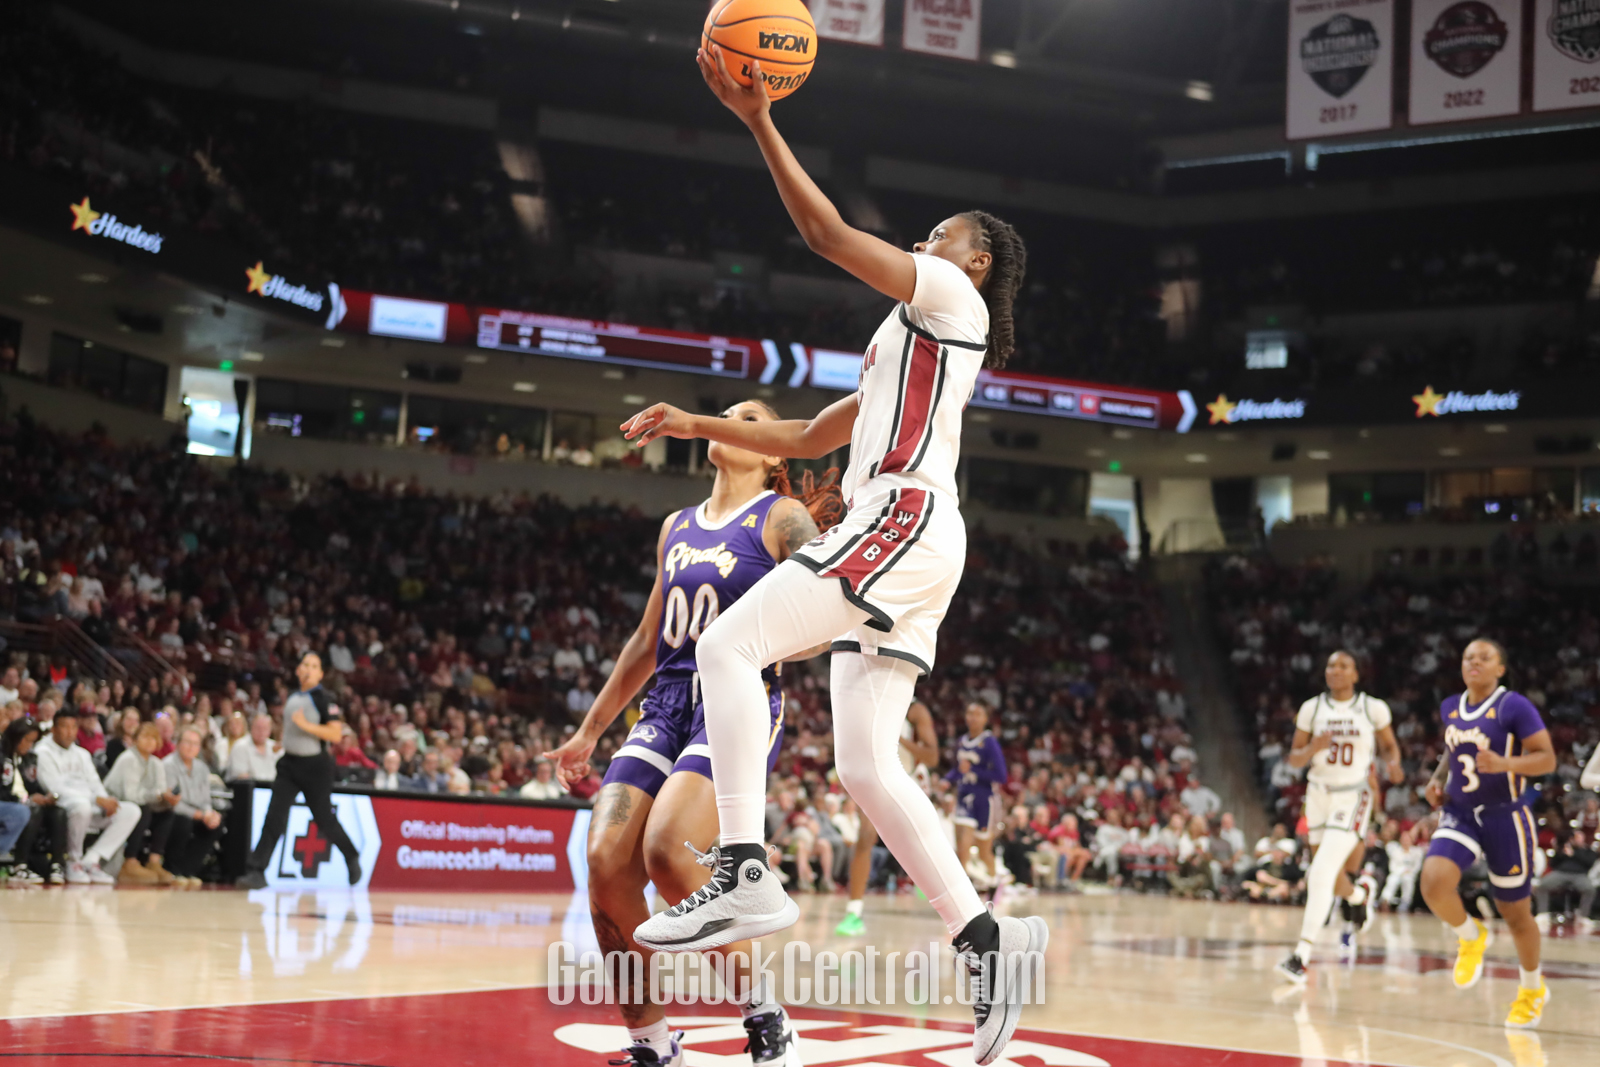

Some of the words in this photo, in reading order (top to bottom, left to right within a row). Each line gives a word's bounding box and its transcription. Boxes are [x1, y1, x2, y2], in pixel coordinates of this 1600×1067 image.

[758, 31, 810, 54] NCAA
[1430, 33, 1502, 53] CHAMPIONS
[1443, 88, 1486, 109] 2022
[1319, 103, 1358, 124] 2017
[665, 541, 738, 582] Pirates
[663, 583, 719, 649] 00
[1327, 741, 1354, 767] 30
[1457, 753, 1481, 793] 3
[401, 819, 446, 840] Official
[447, 822, 505, 845] Streaming
[506, 825, 554, 844] Platform
[397, 845, 556, 873] GamecocksPlus.com
